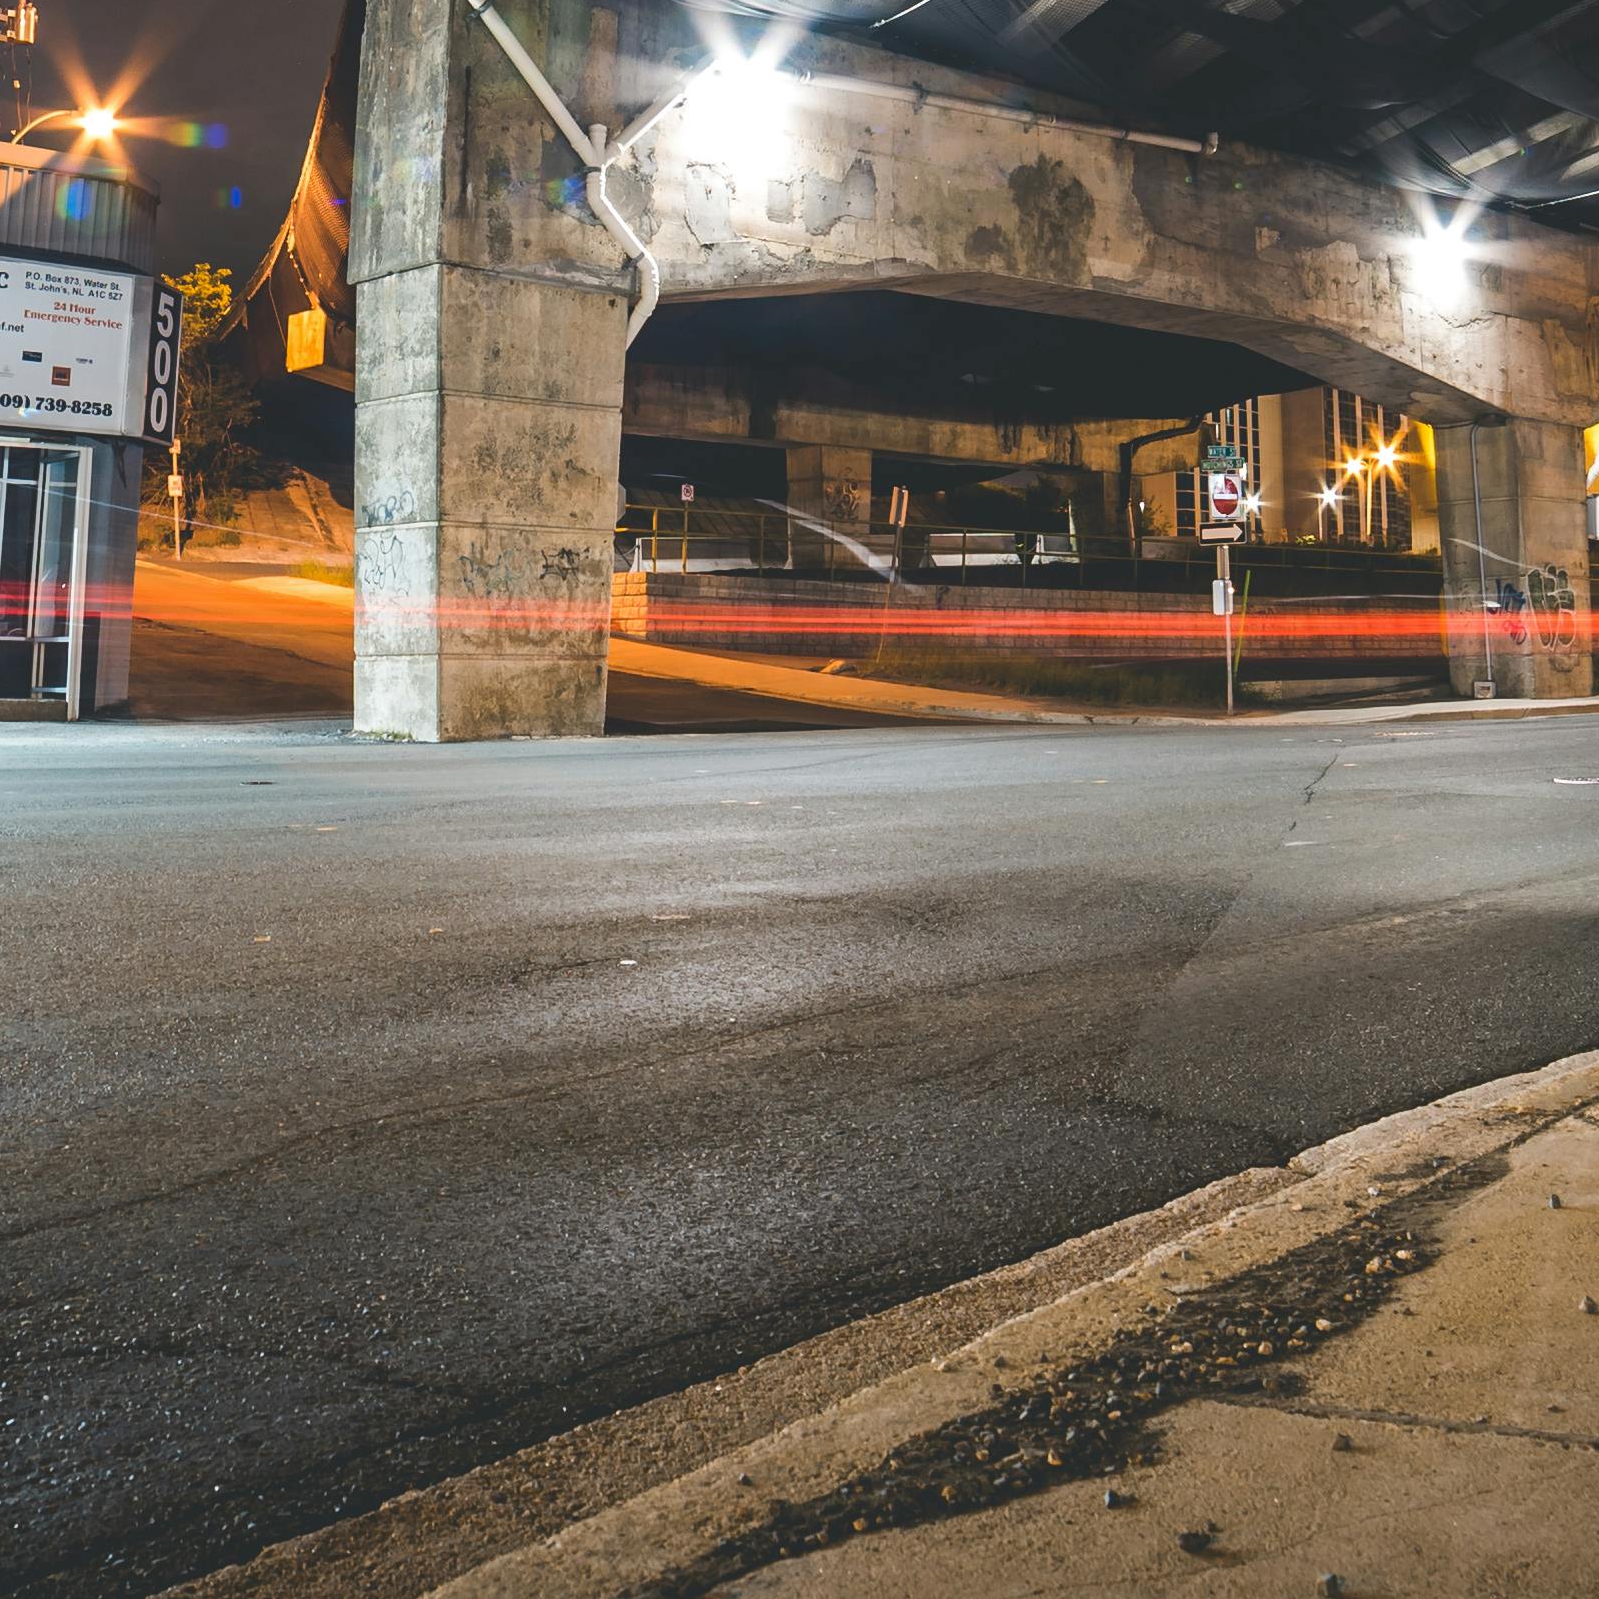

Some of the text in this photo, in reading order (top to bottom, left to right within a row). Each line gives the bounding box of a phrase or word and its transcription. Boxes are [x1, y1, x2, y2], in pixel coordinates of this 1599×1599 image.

[25, 271, 42, 281] P.O.
[45, 273, 62, 283] Box
[84, 278, 108, 290] Water
[110, 281, 122, 291] St.
[72, 288, 84, 297] NL
[88, 290, 106, 299] A1C
[53, 301, 97, 315] 24 Hour
[23, 309, 123, 330] Emergency Service
[149, 292, 175, 434] 500
[35, 396, 113, 417] 739-8258
